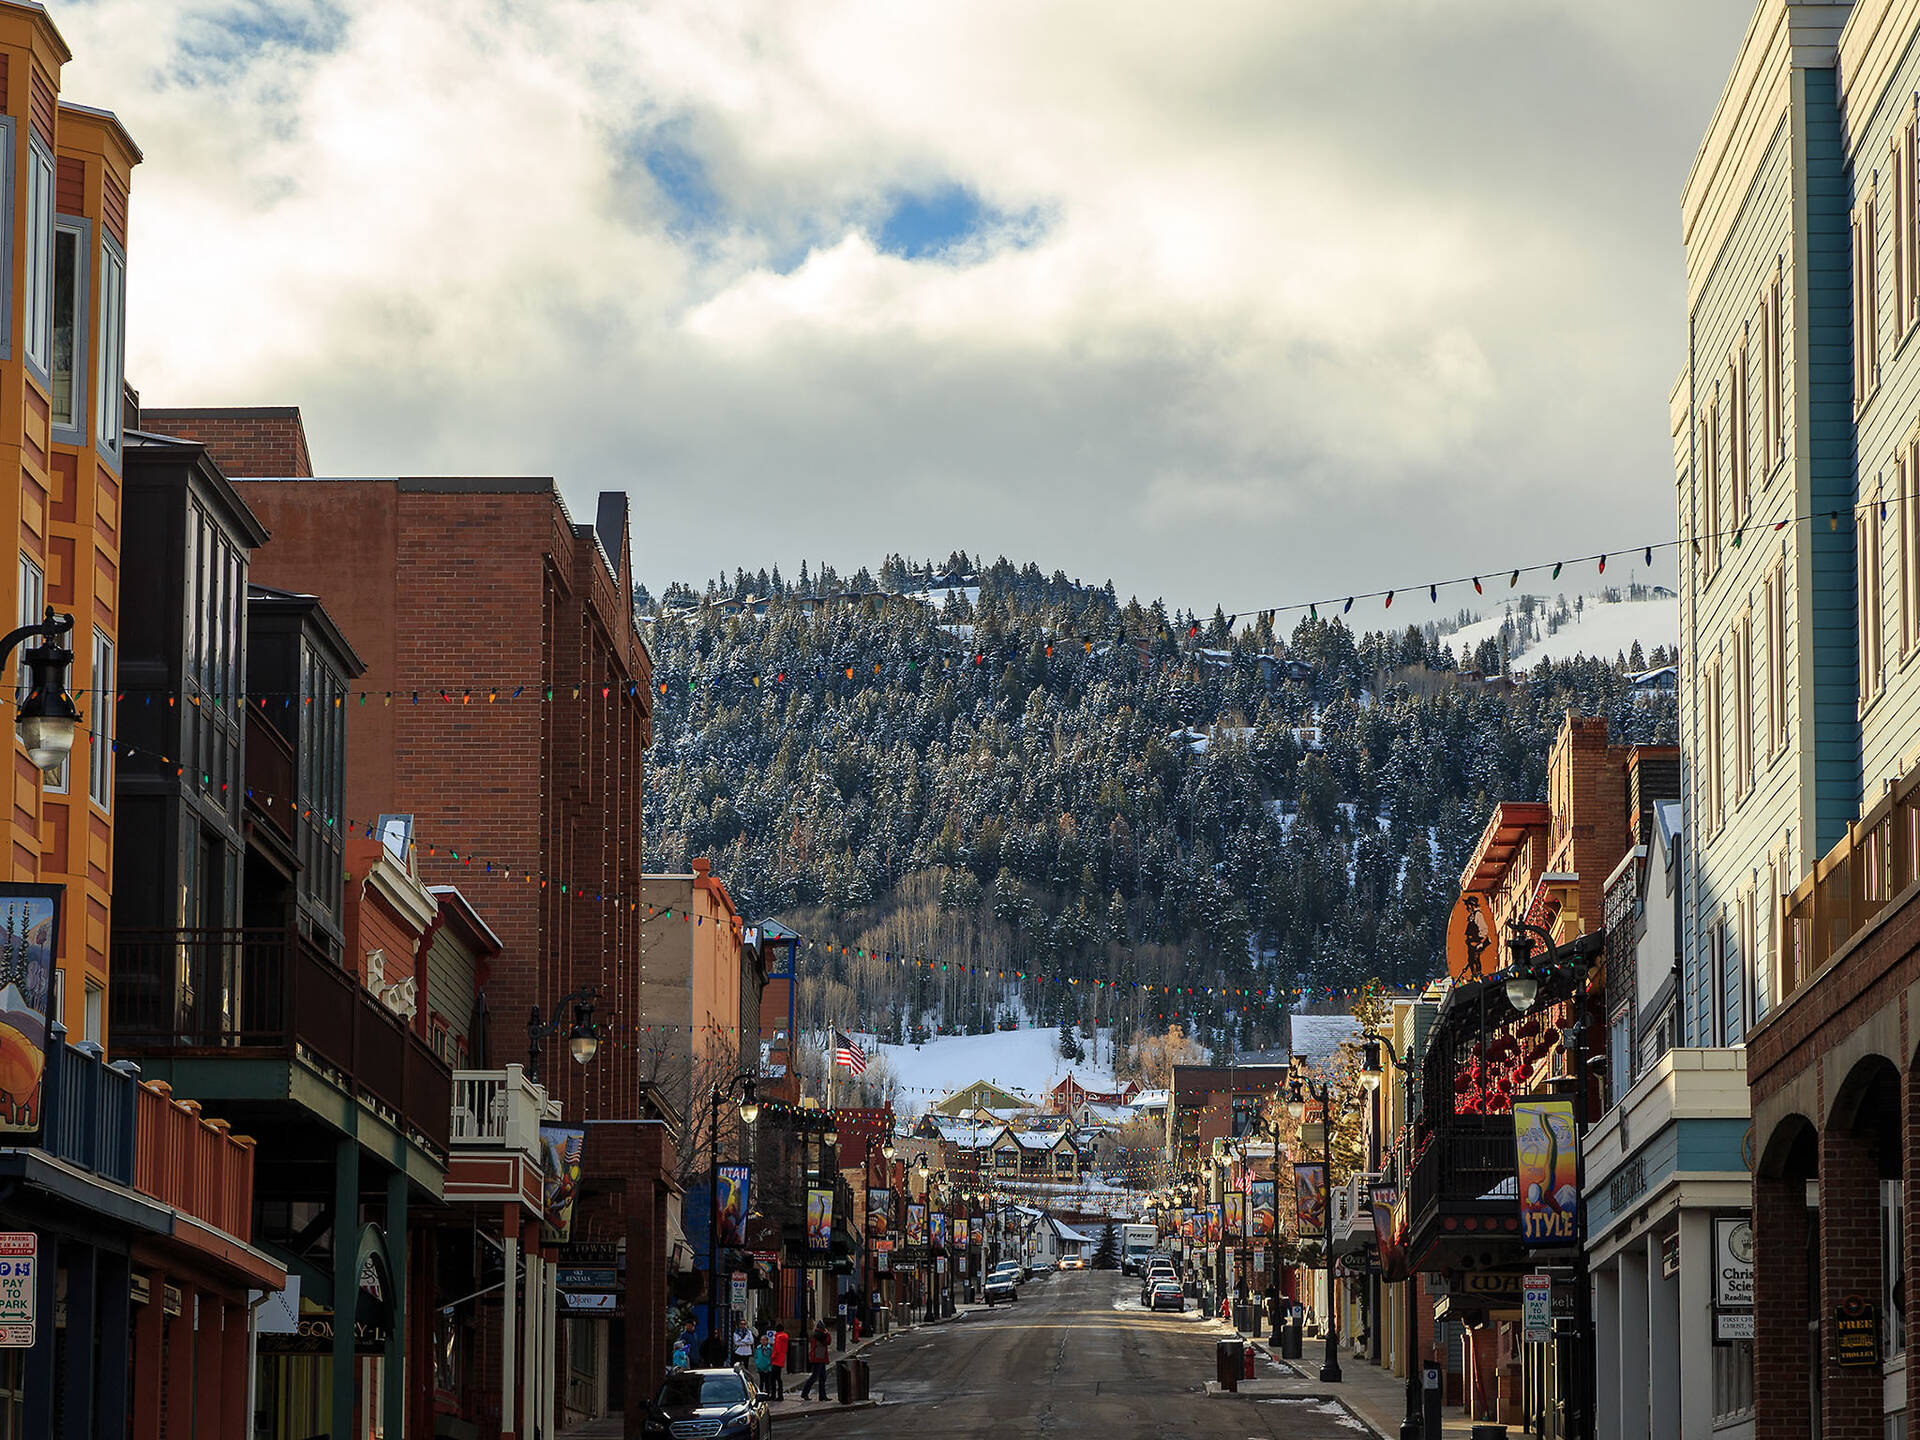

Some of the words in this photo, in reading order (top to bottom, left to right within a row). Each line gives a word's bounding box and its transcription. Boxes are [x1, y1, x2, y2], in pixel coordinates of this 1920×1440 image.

[719, 1167, 748, 1180] UTAH
[1525, 1211, 1573, 1239] STYLE
[3, 1279, 24, 1287] PAY
[1728, 1281, 1753, 1291] Scie
[6, 1289, 21, 1298] TO
[1724, 1293, 1752, 1302] Reading
[0, 1300, 27, 1308] PARK
[1838, 1319, 1873, 1330] FREE
[1841, 1351, 1874, 1359] TROLLEY
